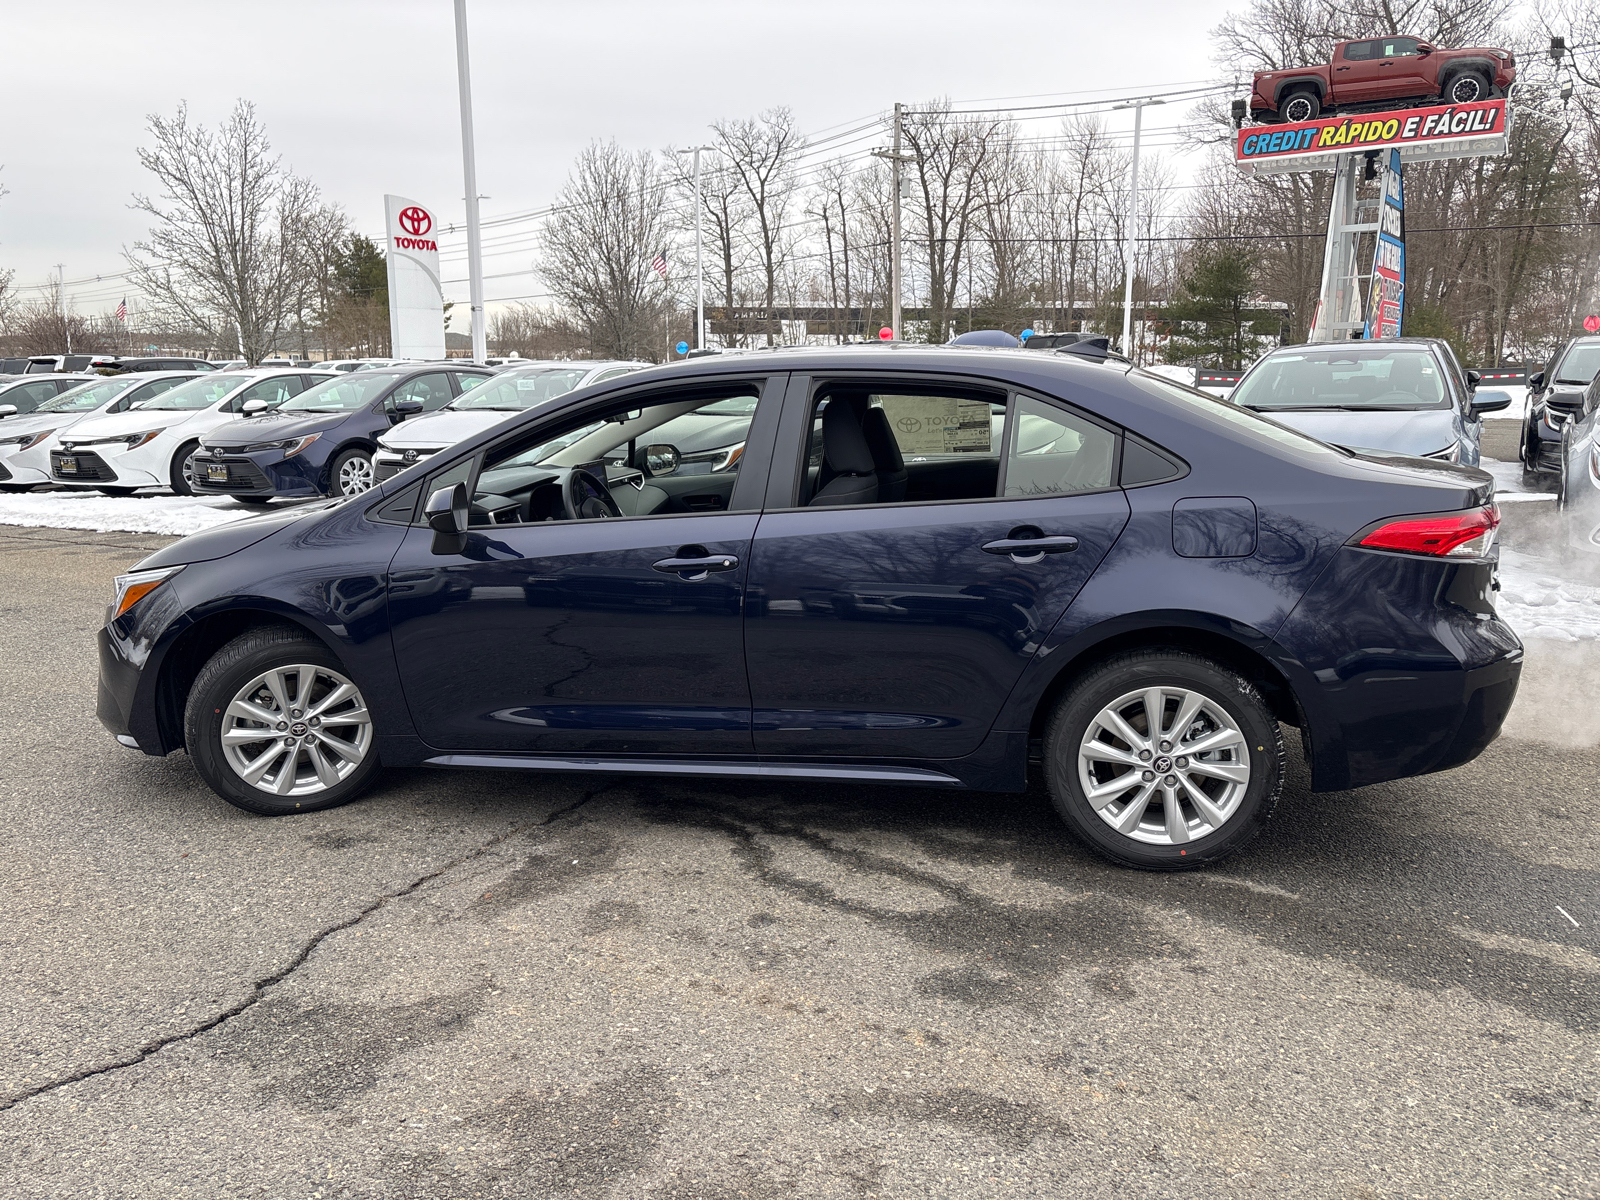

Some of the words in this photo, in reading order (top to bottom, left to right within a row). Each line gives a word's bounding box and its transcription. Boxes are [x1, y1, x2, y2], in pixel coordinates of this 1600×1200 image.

[1243, 128, 1318, 155] CREDIT
[1318, 119, 1400, 147] RÁPIDO
[1402, 116, 1421, 138] E
[1421, 107, 1498, 136] FÁCIL!
[393, 236, 438, 252] TOYOTA
[924, 415, 975, 426] TOYOTA
